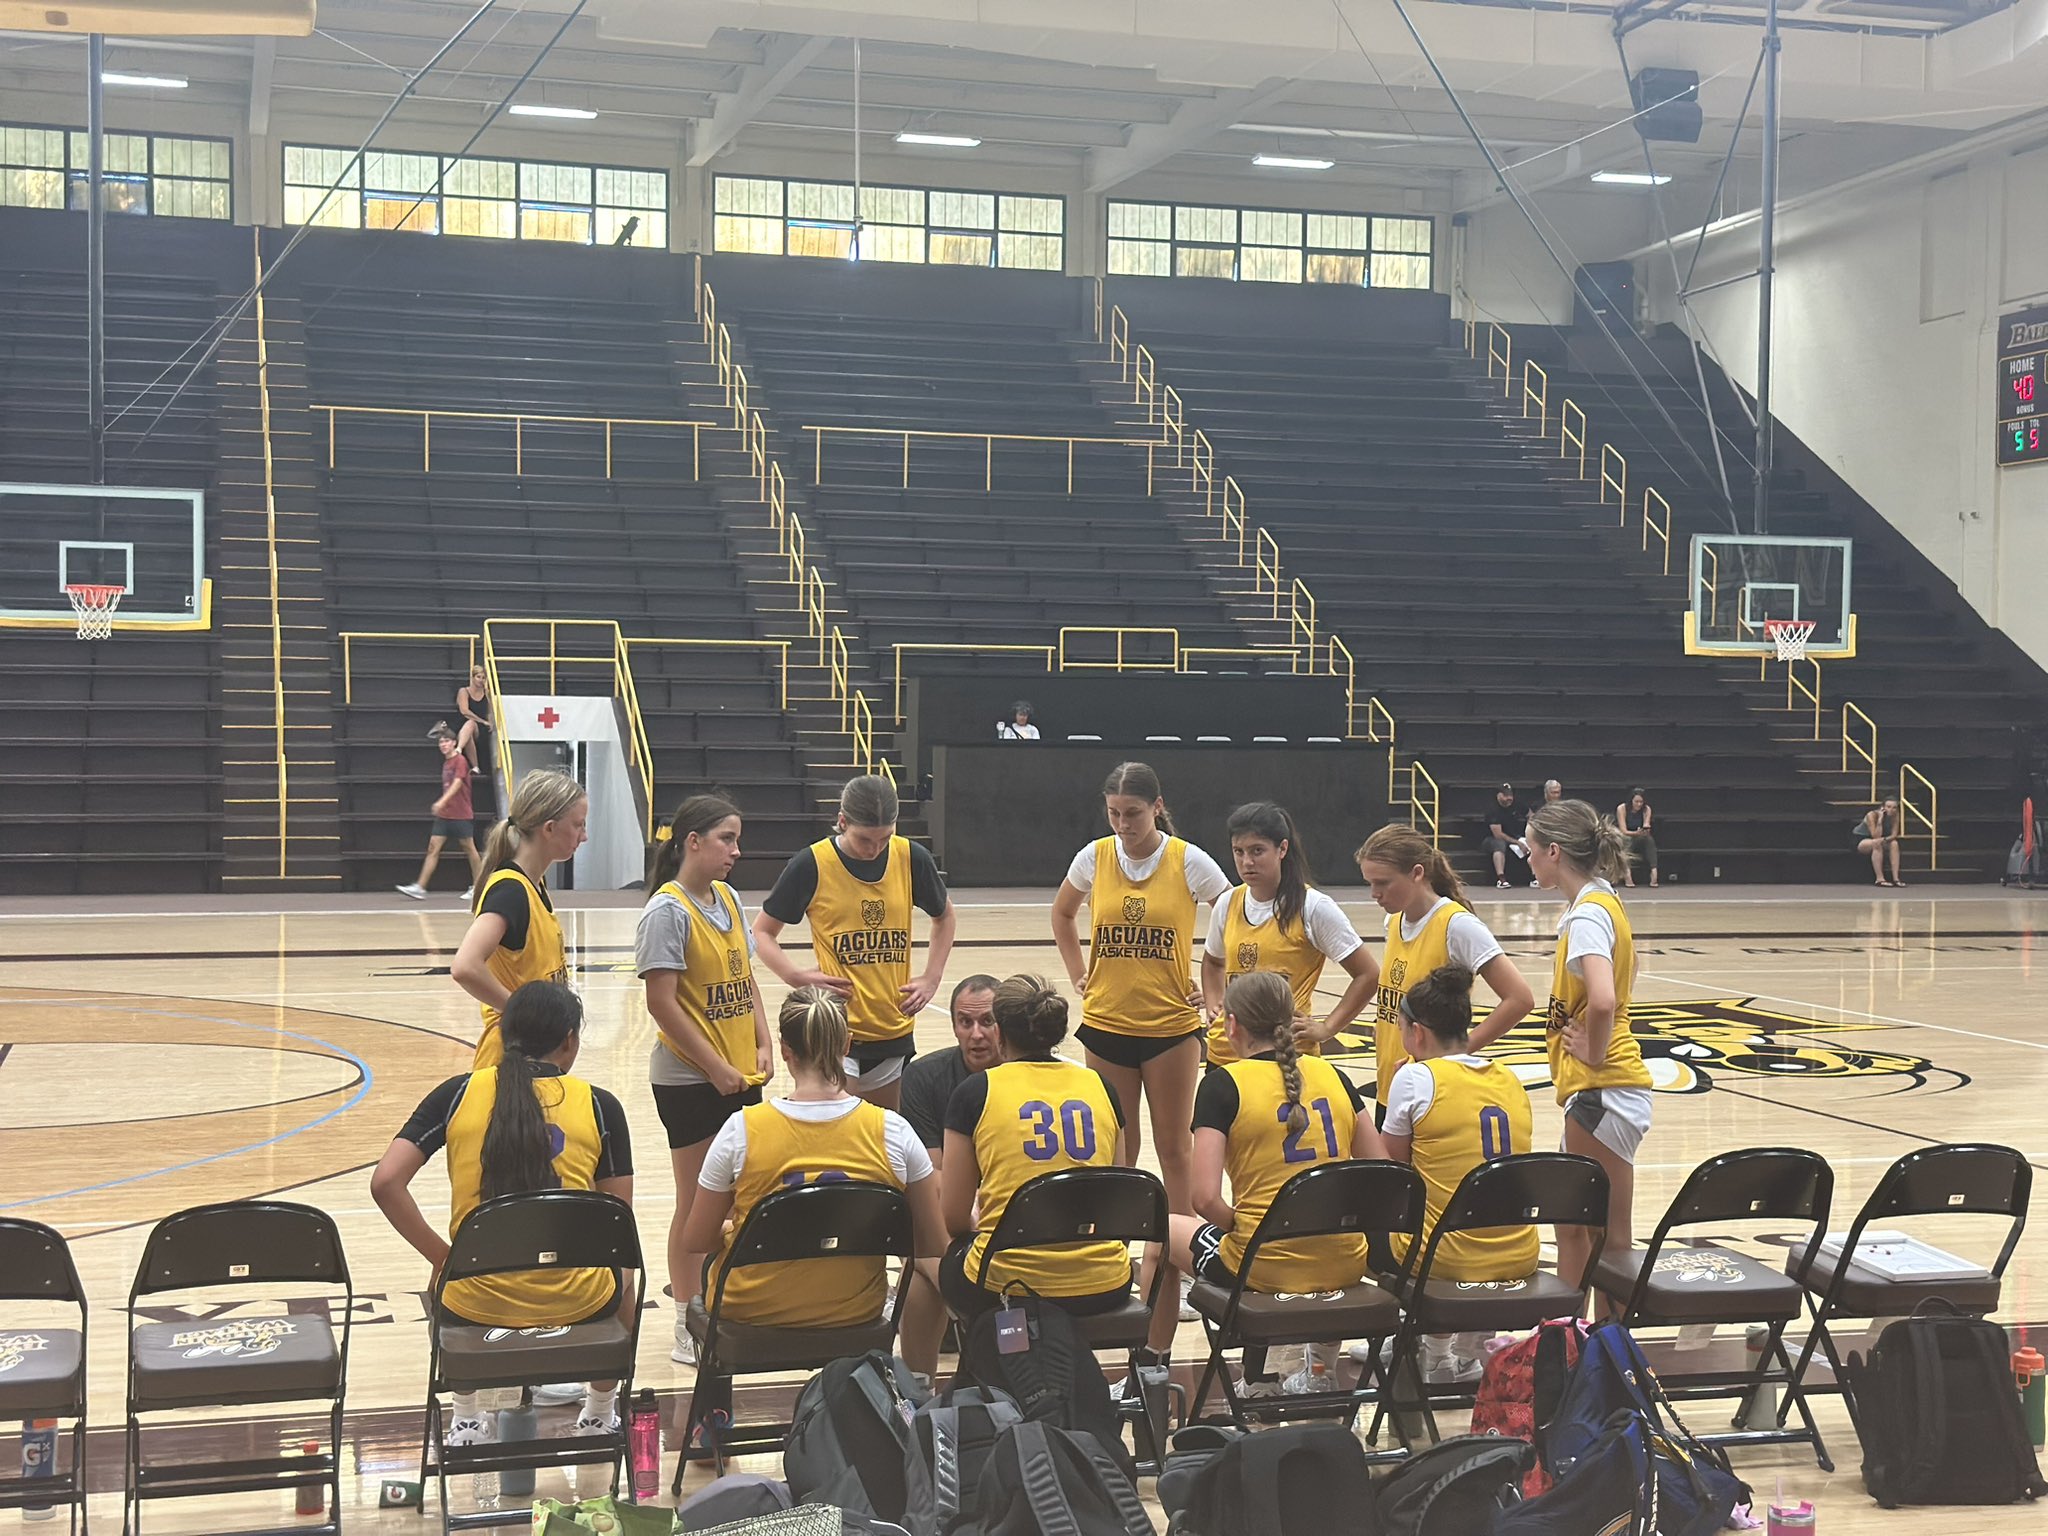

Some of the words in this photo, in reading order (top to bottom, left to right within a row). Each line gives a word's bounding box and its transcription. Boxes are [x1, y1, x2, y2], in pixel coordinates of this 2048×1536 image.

[2009, 357, 2035, 375] HOME
[2013, 374, 2035, 401] 40
[2016, 404, 2035, 415] BONUS
[2007, 420, 2025, 432] FOULS
[2014, 430, 2025, 451] 5
[2029, 428, 2039, 450] 5
[833, 931, 907, 953] JAGUARS
[1096, 926, 1175, 948] JAGUARS
[838, 952, 906, 966] ASKETBALL
[1019, 1099, 1095, 1162] 30
[1276, 1097, 1339, 1164] 21
[1479, 1105, 1512, 1162] 0
